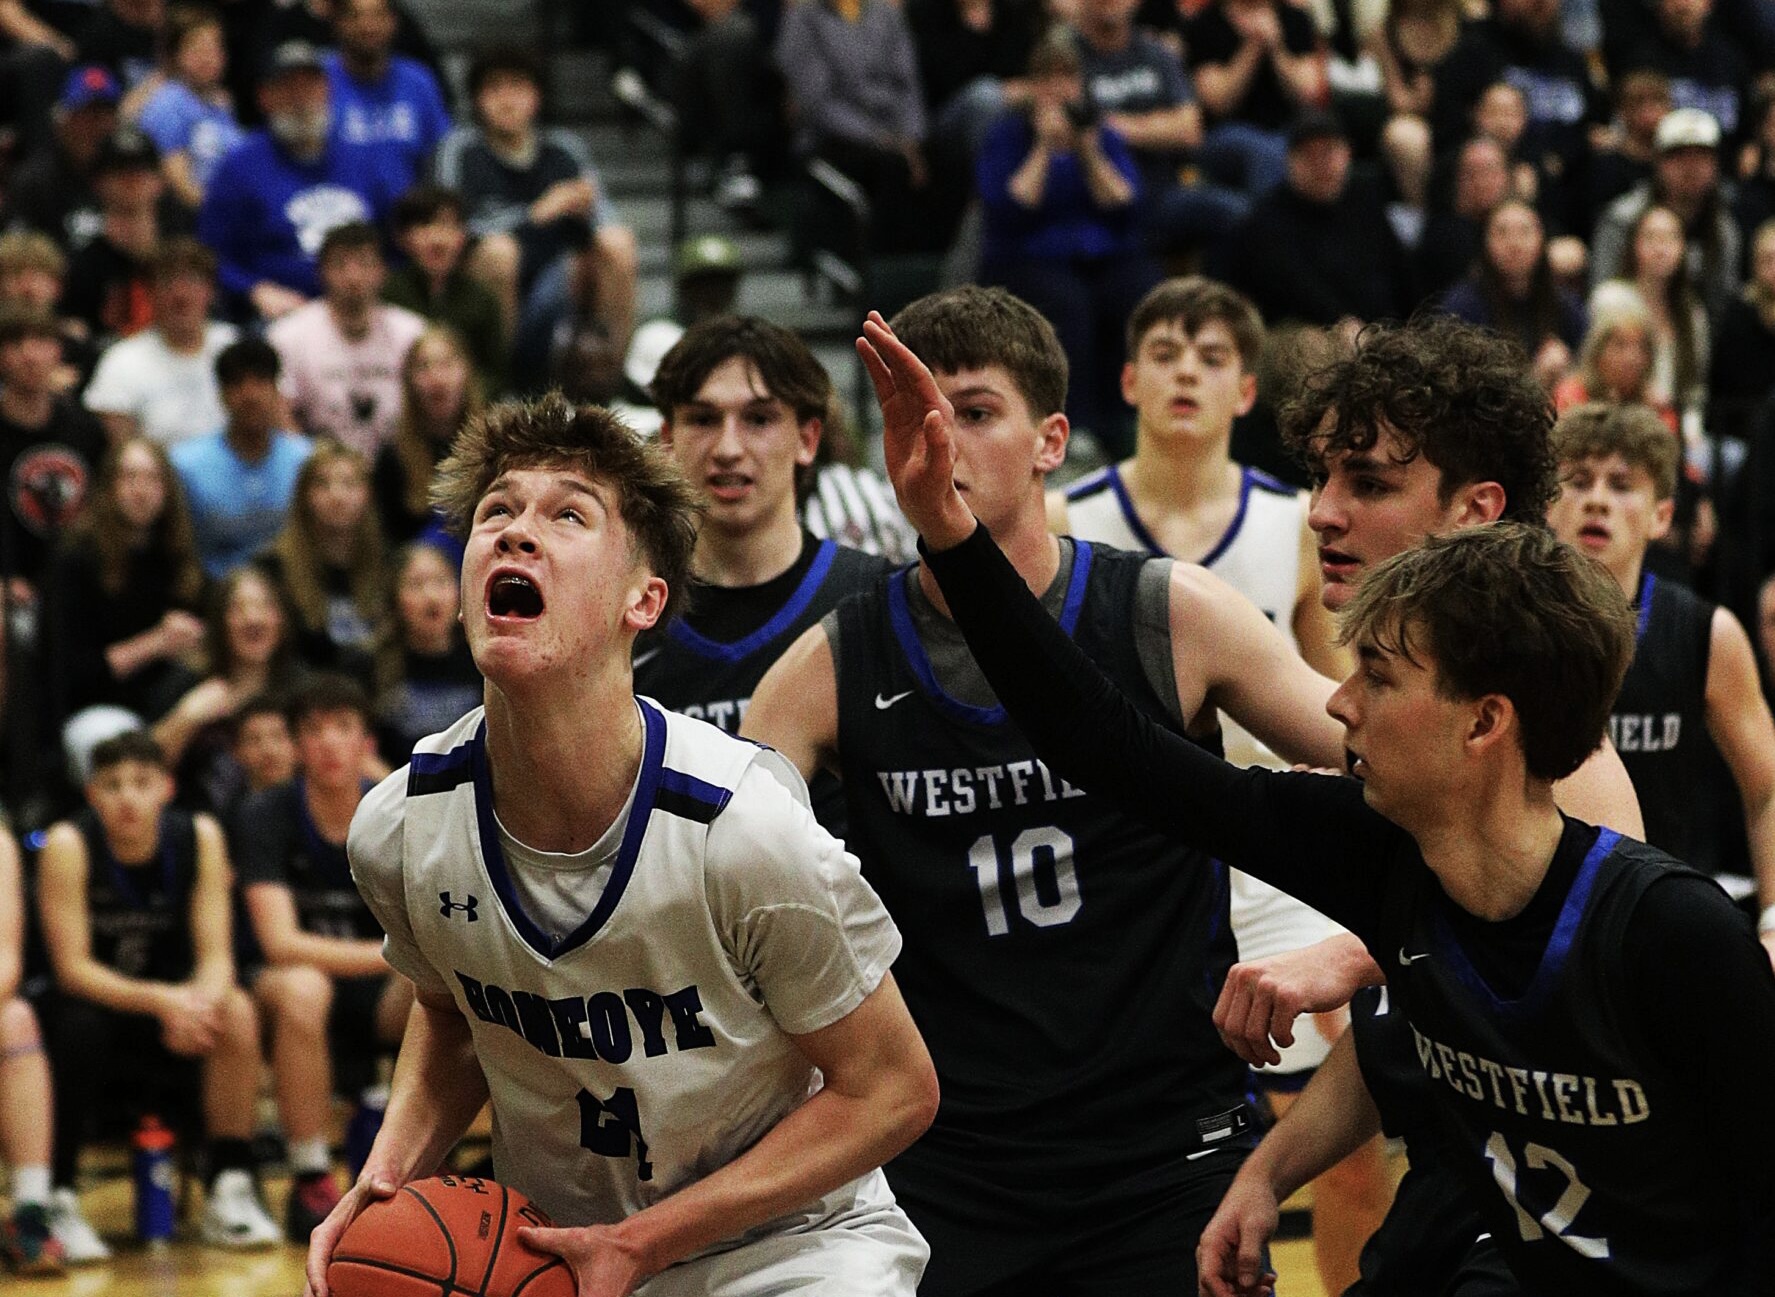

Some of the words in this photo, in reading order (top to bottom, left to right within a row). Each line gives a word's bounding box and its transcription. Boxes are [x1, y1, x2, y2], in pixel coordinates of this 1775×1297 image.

[967, 825, 1083, 936] 10
[1236, 1115, 1247, 1127] L
[1409, 1021, 1650, 1126] WESTFIELD
[1485, 1131, 1610, 1259] 12
